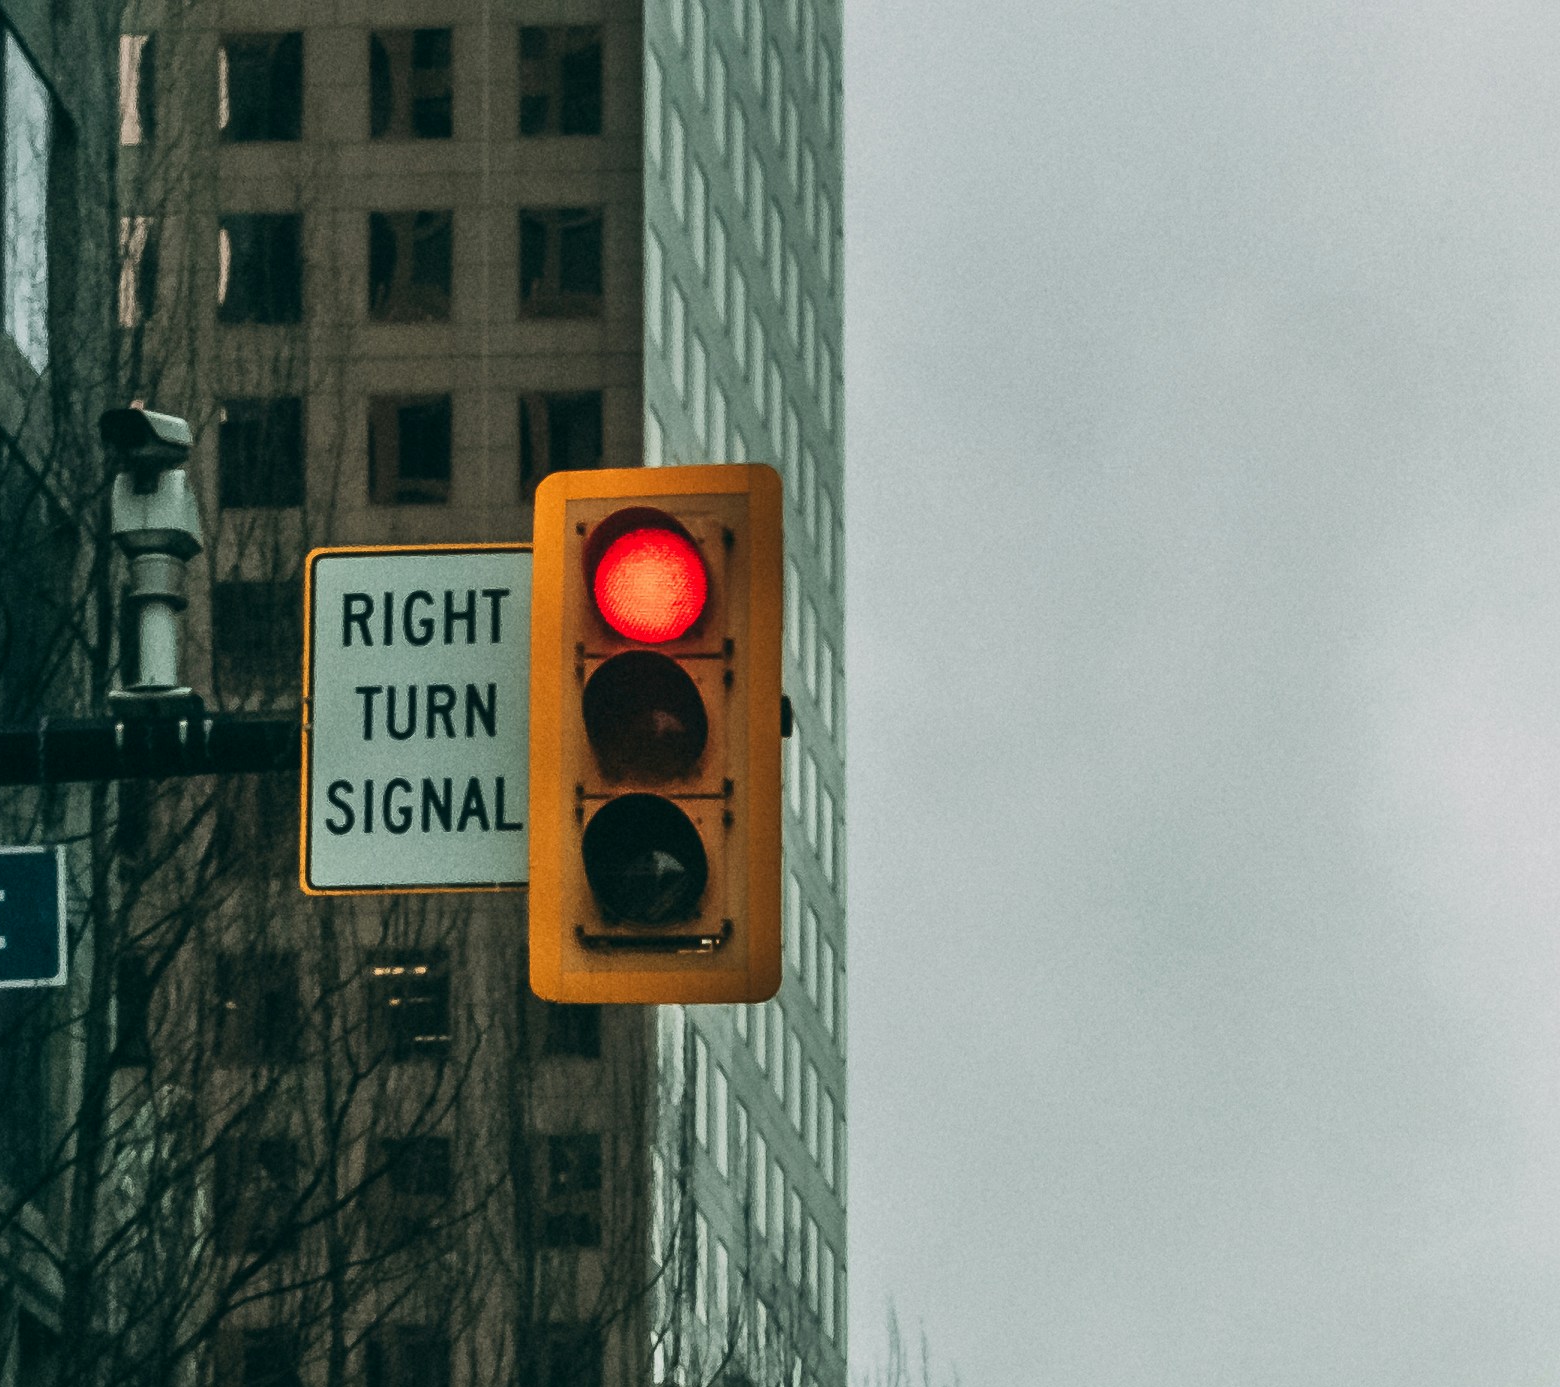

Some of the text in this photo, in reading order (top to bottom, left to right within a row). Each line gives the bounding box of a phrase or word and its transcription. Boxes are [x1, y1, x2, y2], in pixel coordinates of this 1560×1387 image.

[344, 589, 511, 648] RIGHT
[357, 682, 498, 741] TURN
[325, 777, 524, 835] SIGNAL
